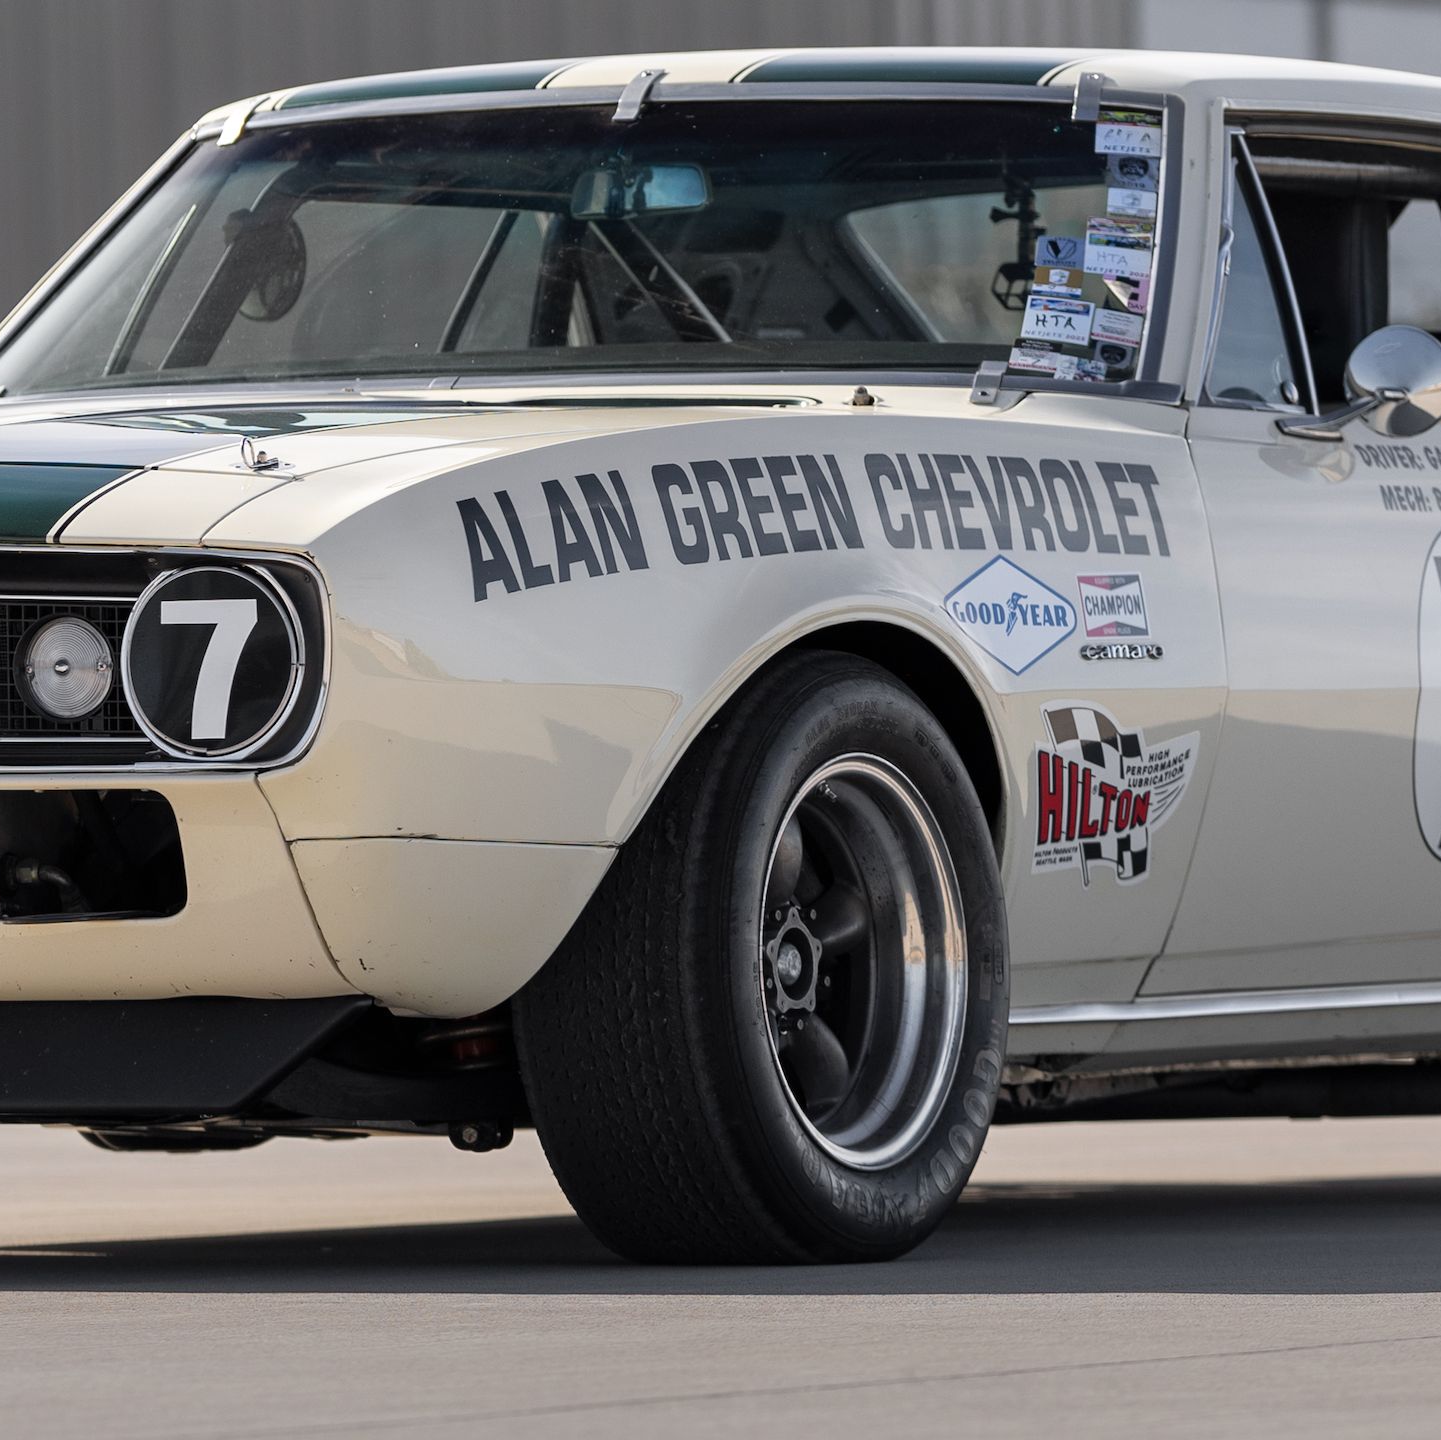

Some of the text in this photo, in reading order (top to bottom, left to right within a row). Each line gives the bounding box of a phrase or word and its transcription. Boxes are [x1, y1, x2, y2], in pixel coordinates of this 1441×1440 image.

[1096, 251, 1128, 266] HTA
[1035, 313, 1076, 330] HTA
[1353, 444, 1424, 471] DRIVER:
[1379, 484, 1432, 512] MECH:
[455, 453, 1171, 603] ALAN GREEN CHEVROLET
[1084, 594, 1142, 616] CHAMPION
[1086, 644, 1164, 660] camaro
[160, 598, 258, 740] 7
[1126, 748, 1191, 776] PERFORMANCE
[1148, 749, 1170, 763] HIGH
[1127, 764, 1185, 788] LUBRICATION
[1037, 750, 1151, 846] HILTON
[1034, 849, 1052, 858] HILTON
